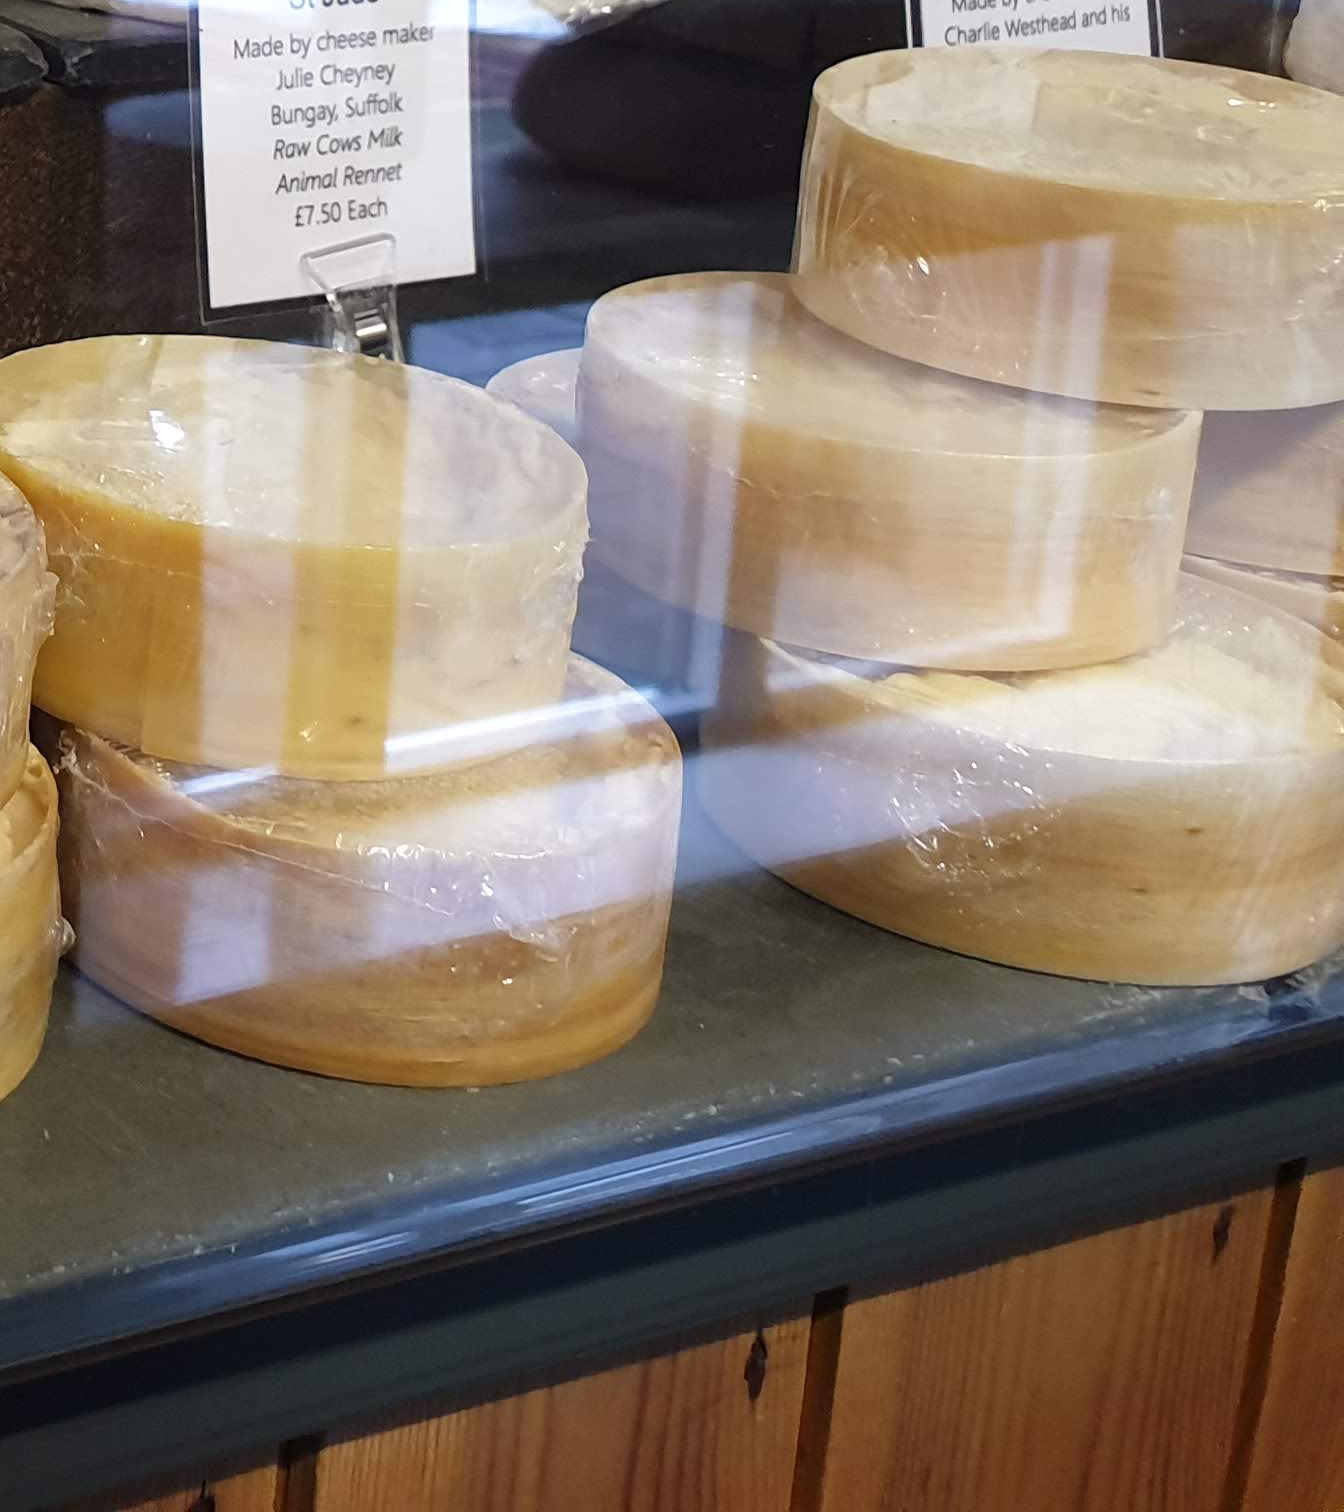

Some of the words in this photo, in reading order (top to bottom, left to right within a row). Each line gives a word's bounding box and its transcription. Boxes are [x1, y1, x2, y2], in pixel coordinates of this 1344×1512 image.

[233, 35, 285, 61] Made
[289, 32, 313, 60] by
[316, 29, 378, 52] cheese
[382, 22, 434, 45] maker
[944, 21, 1001, 47] Charlie
[1003, 9, 1077, 39] Westhead
[1081, 5, 1108, 29] and
[1110, 3, 1131, 23] his
[275, 66, 315, 91] Julie
[319, 63, 396, 89] Cheyney
[270, 103, 339, 129] Bungay,
[344, 91, 404, 119] Suffolk
[273, 138, 312, 161] Raw
[316, 133, 363, 156] Cows
[366, 126, 403, 150] Milk
[274, 166, 339, 196] Animal
[342, 162, 403, 187] Rennet
[294, 201, 342, 228] £7.50
[347, 196, 389, 221] Each
